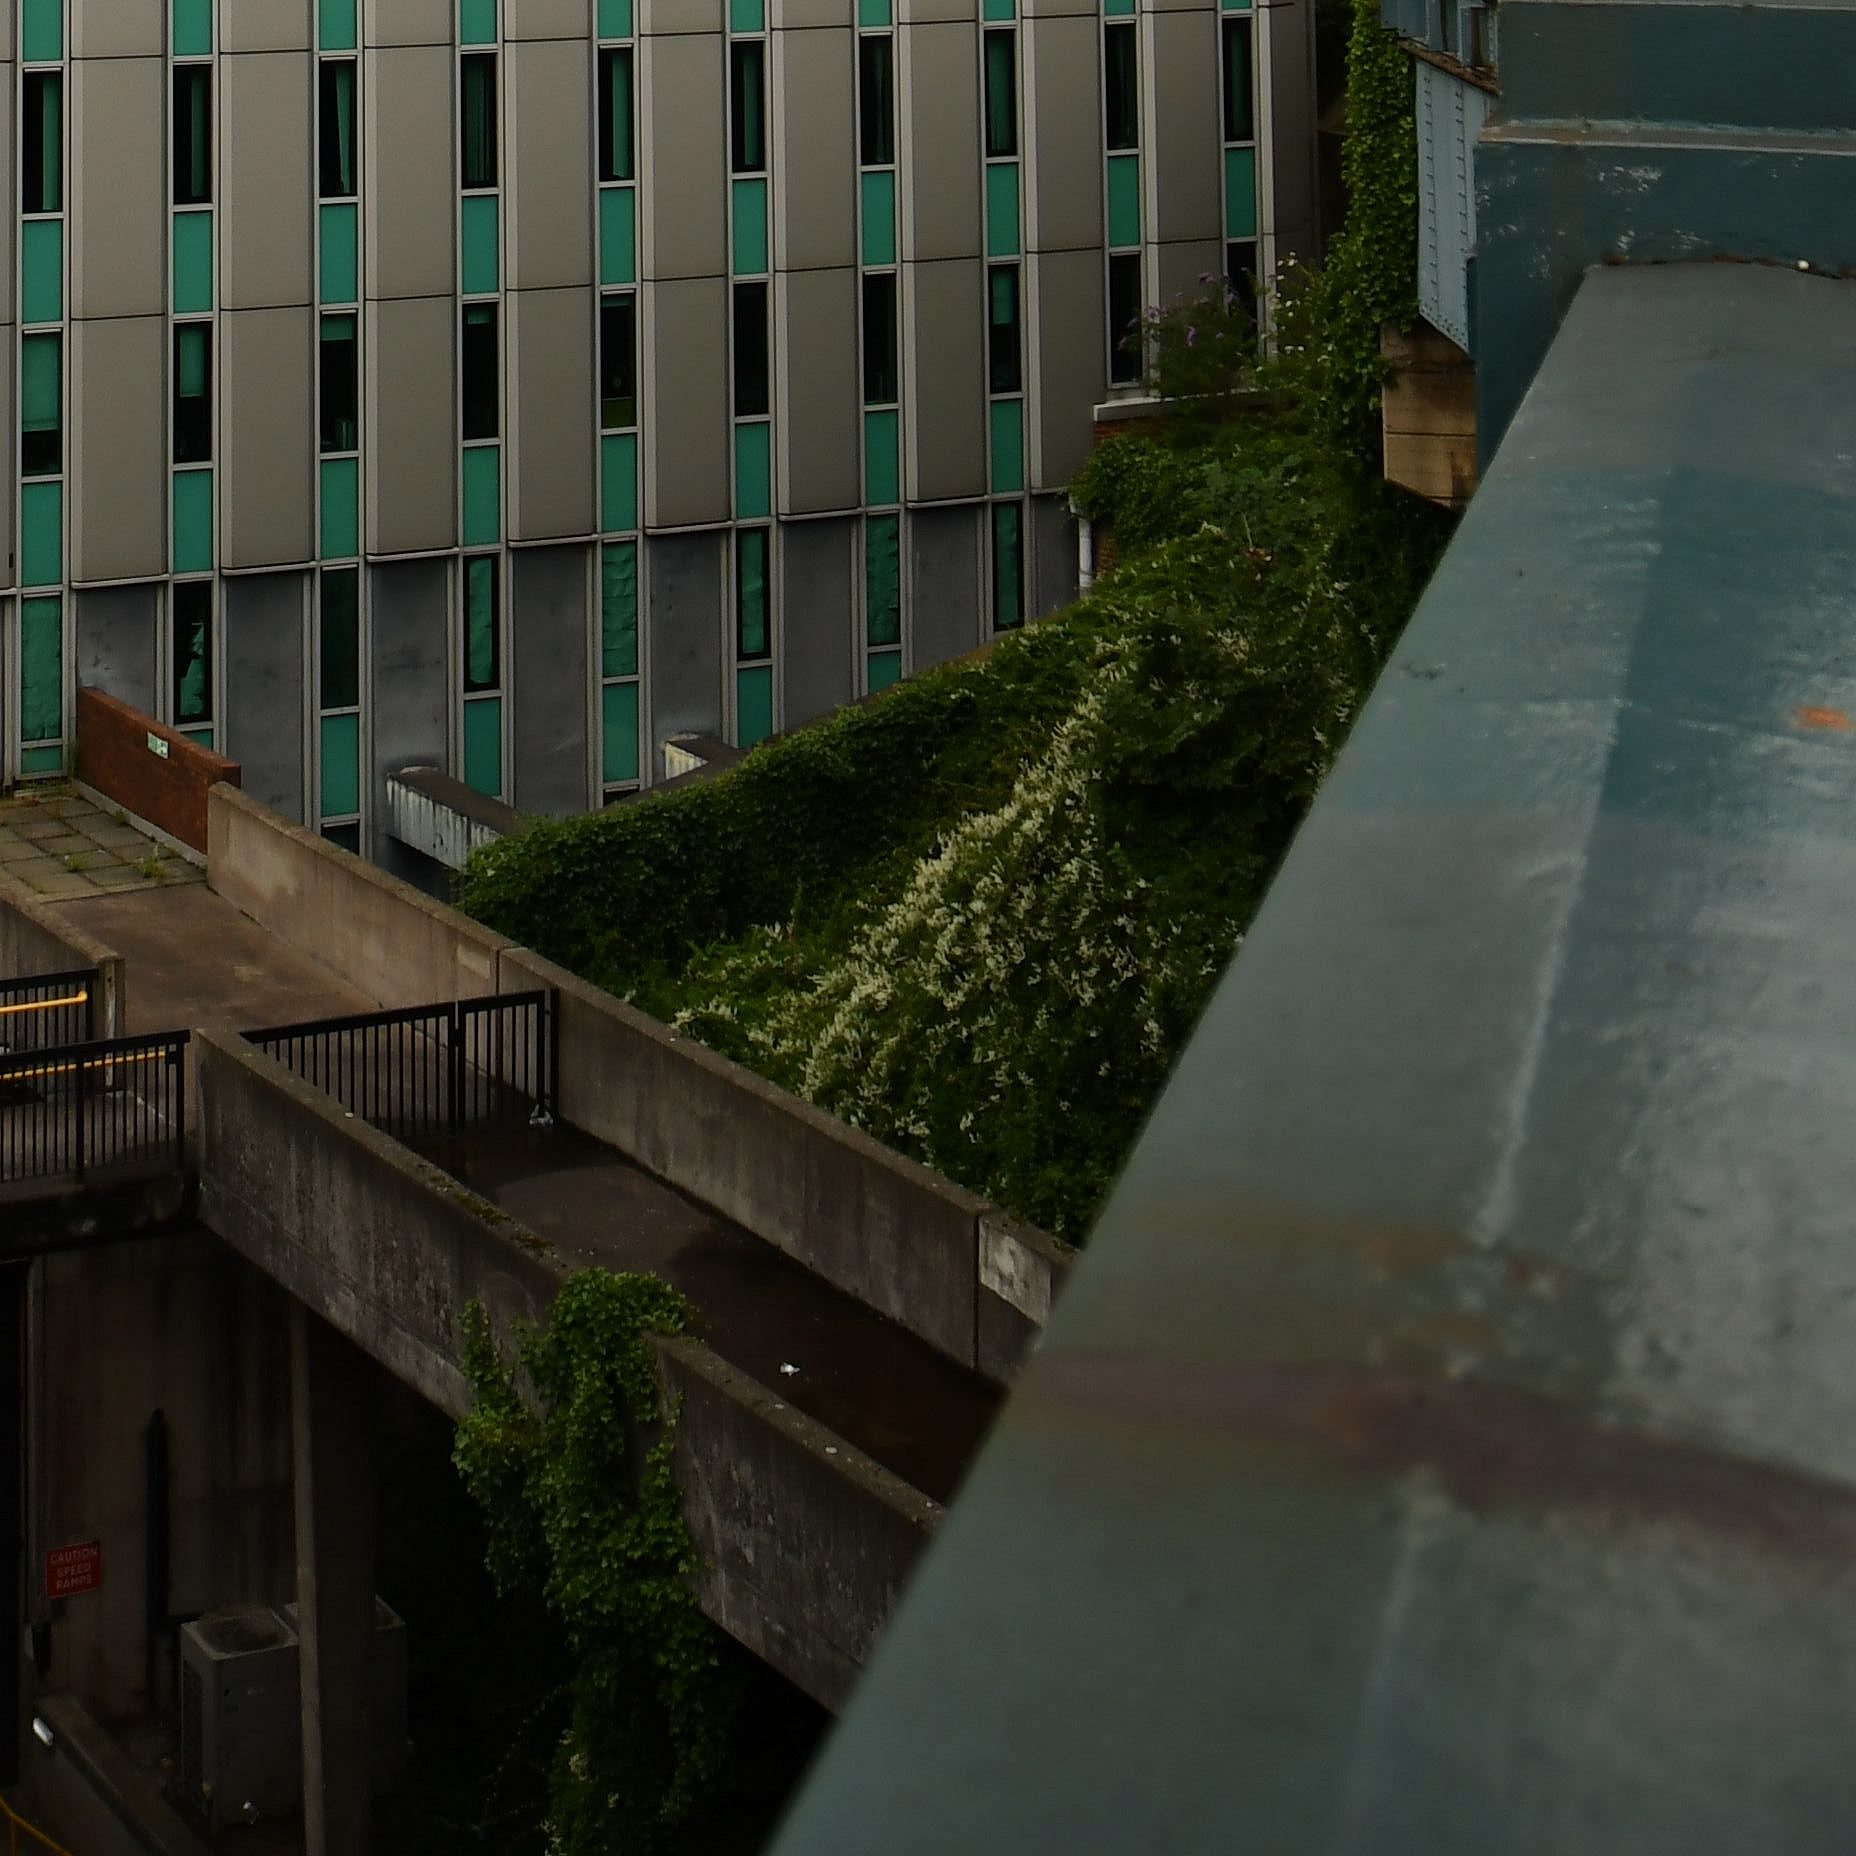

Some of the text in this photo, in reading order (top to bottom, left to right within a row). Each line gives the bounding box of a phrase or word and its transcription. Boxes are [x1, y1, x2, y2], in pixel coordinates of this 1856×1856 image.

[50, 1545, 97, 1564] CAUTION
[56, 1561, 92, 1578] SPEED
[56, 1574, 92, 1591] RAMPS
